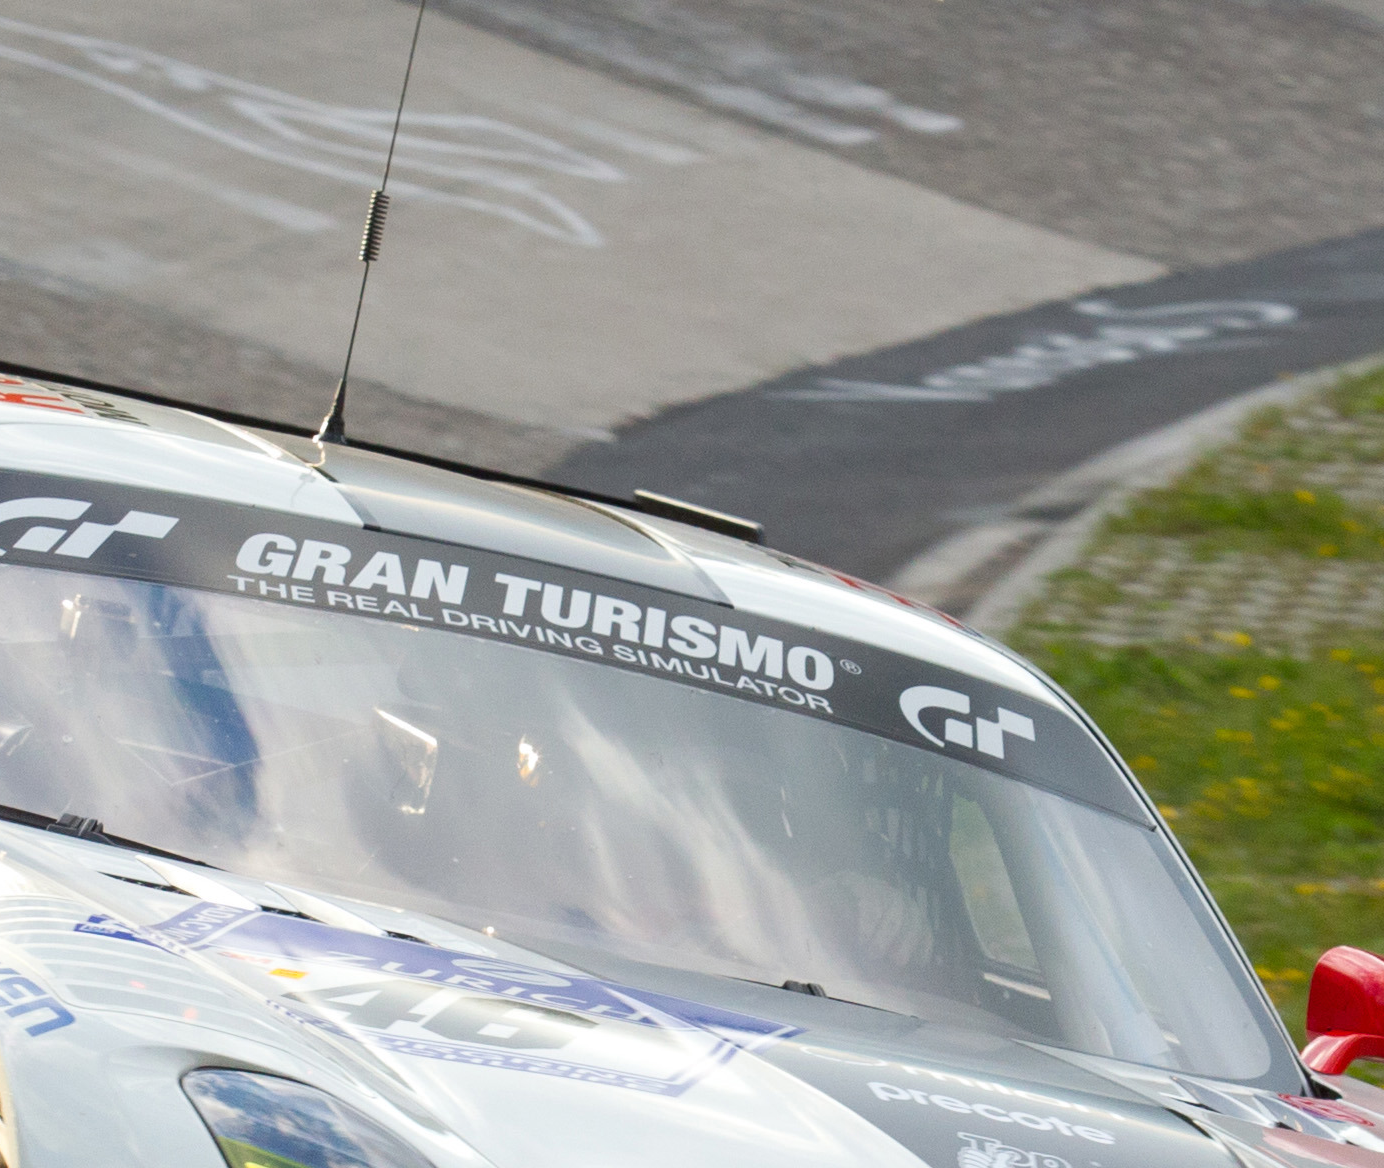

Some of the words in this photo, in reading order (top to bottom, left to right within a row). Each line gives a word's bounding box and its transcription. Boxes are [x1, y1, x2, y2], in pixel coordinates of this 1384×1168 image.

[226, 575, 324, 603] THE
[326, 588, 434, 622] REAL
[442, 604, 604, 657] DRIVING
[612, 643, 835, 715] SIMULATOR
[234, 531, 467, 605] GRAN
[495, 571, 836, 692] TURISMO
[281, 976, 601, 1053] 46
[323, 950, 653, 1023] ZURICH
[867, 1081, 1117, 1145] precote
